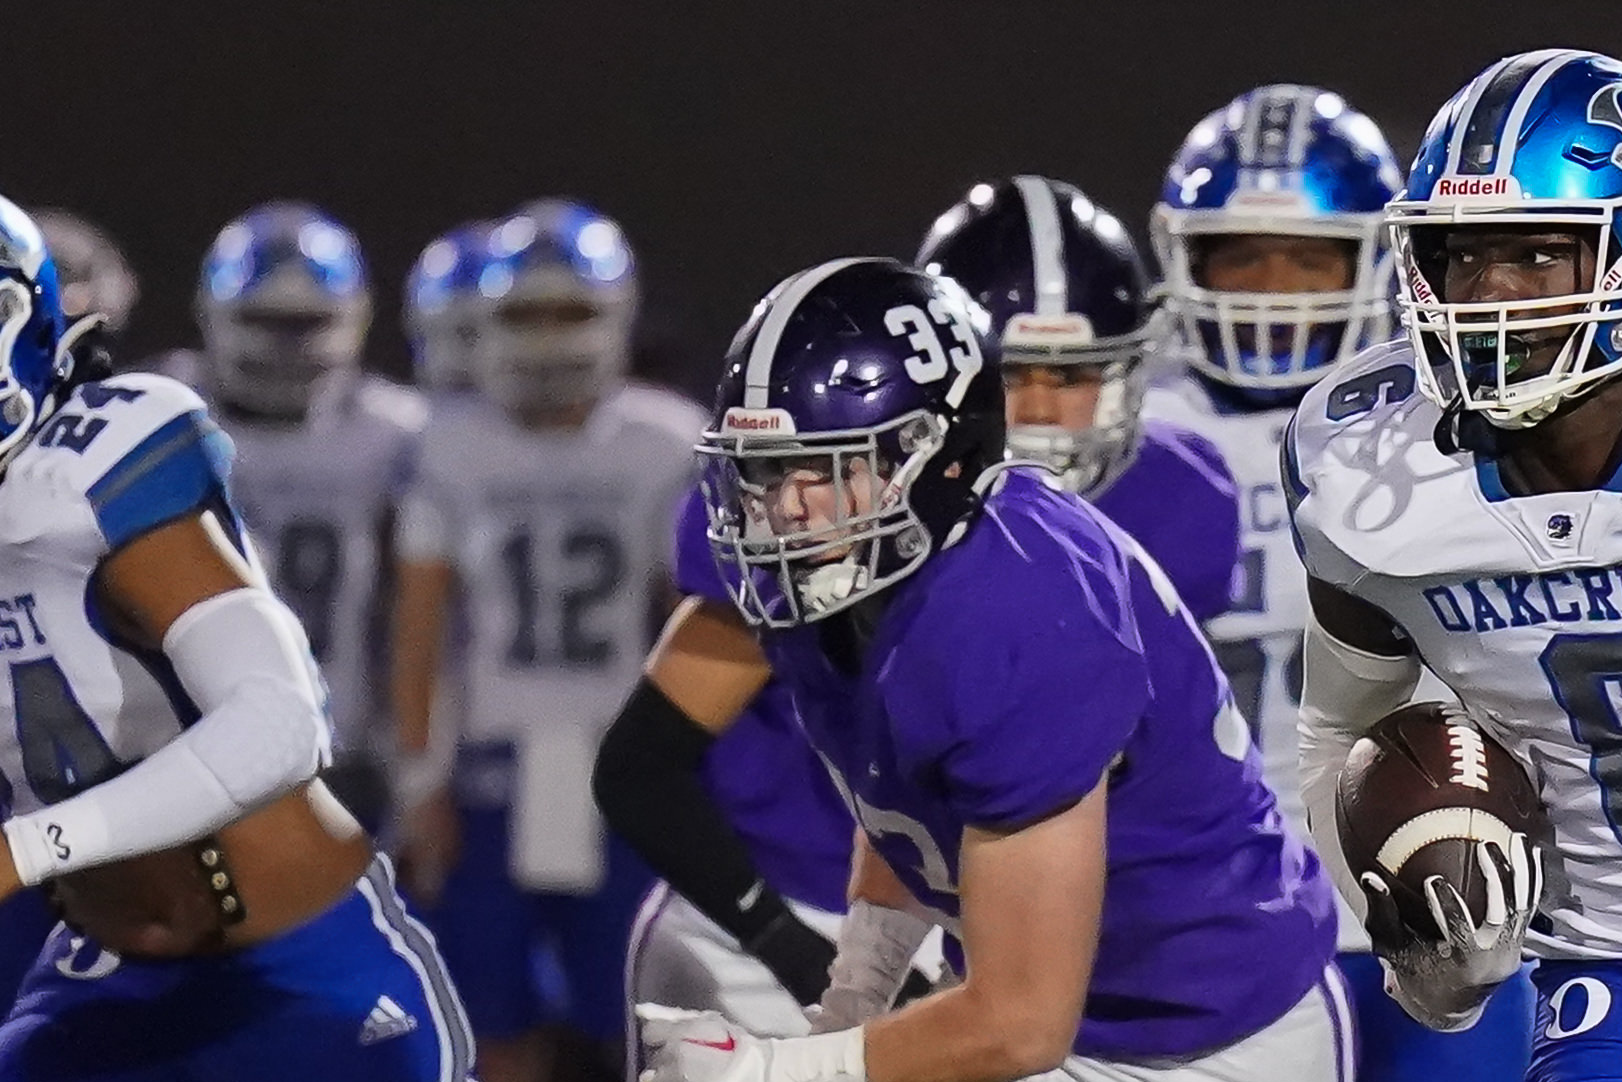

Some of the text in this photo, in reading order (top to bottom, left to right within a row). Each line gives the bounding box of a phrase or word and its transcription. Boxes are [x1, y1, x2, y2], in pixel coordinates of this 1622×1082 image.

[1440, 179, 1507, 195] Riddell
[883, 296, 984, 385] 33
[1326, 364, 1416, 421] 6
[502, 522, 626, 664] 12
[1546, 976, 1612, 1039] O
